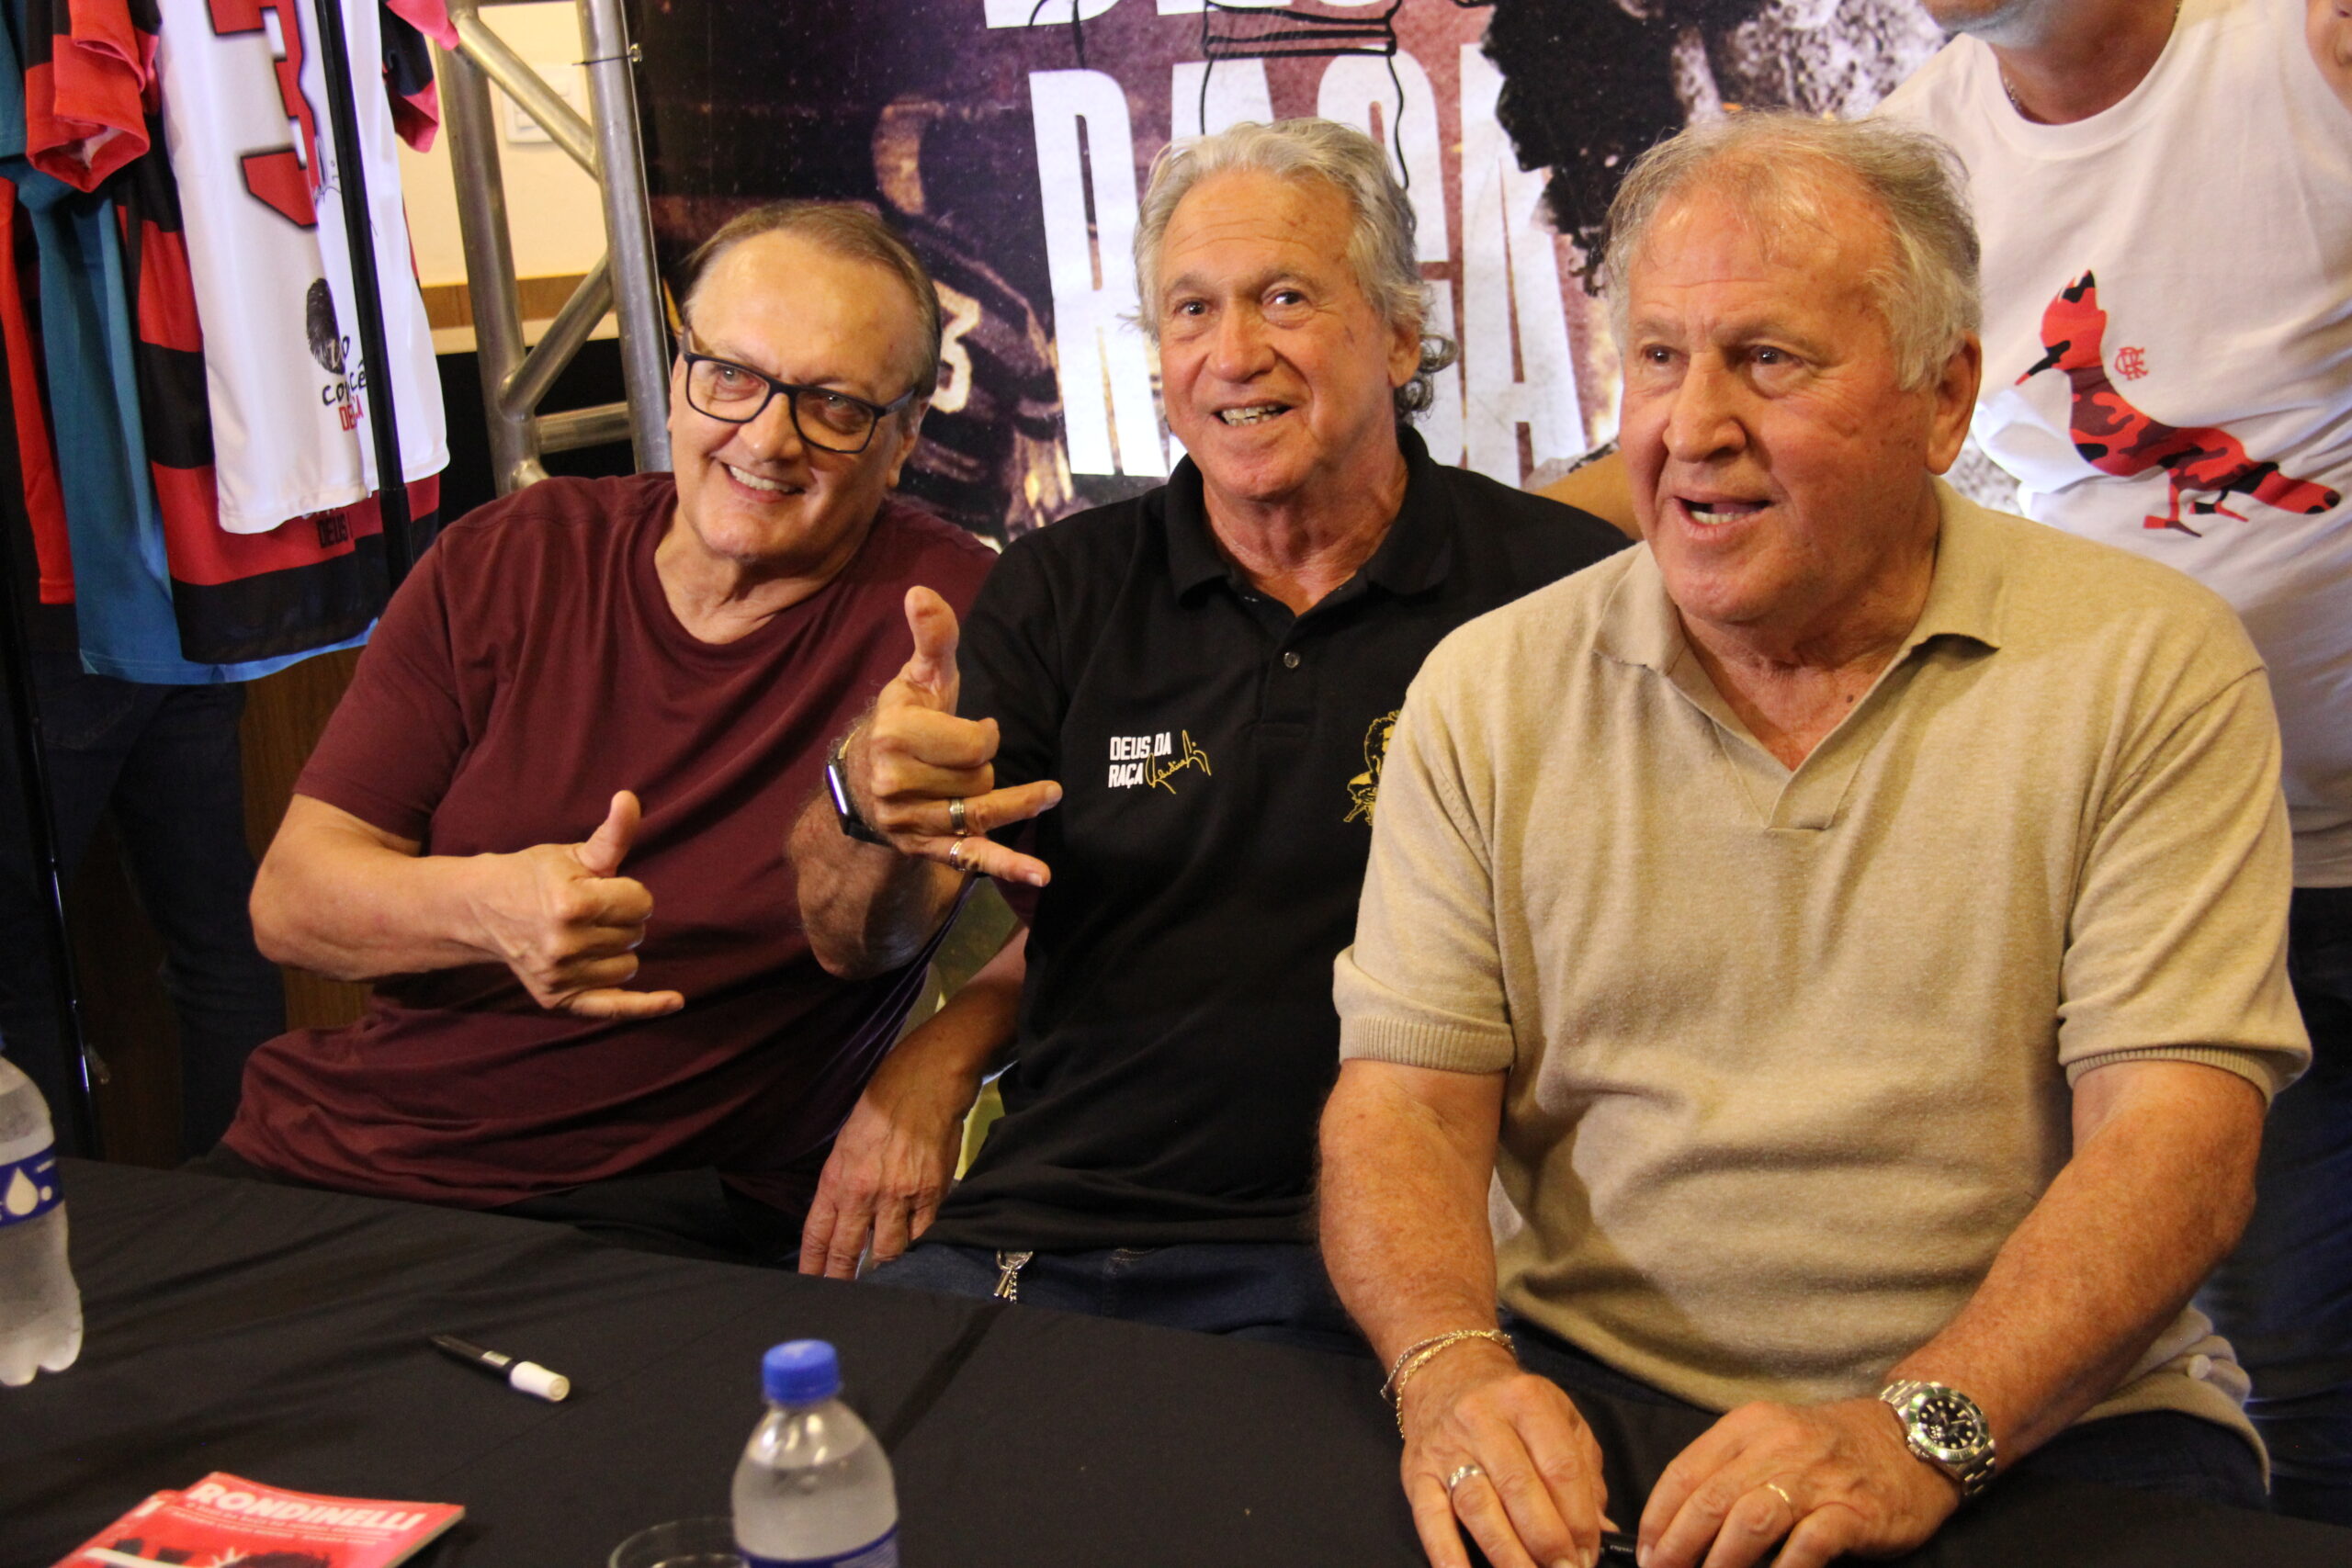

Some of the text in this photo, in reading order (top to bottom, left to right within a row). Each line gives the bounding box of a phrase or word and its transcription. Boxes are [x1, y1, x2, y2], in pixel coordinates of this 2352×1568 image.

[1110, 732, 1172, 761] DEUS DA
[1108, 762, 1144, 789] RAÇA
[187, 1482, 426, 1531] RONDINELLI
